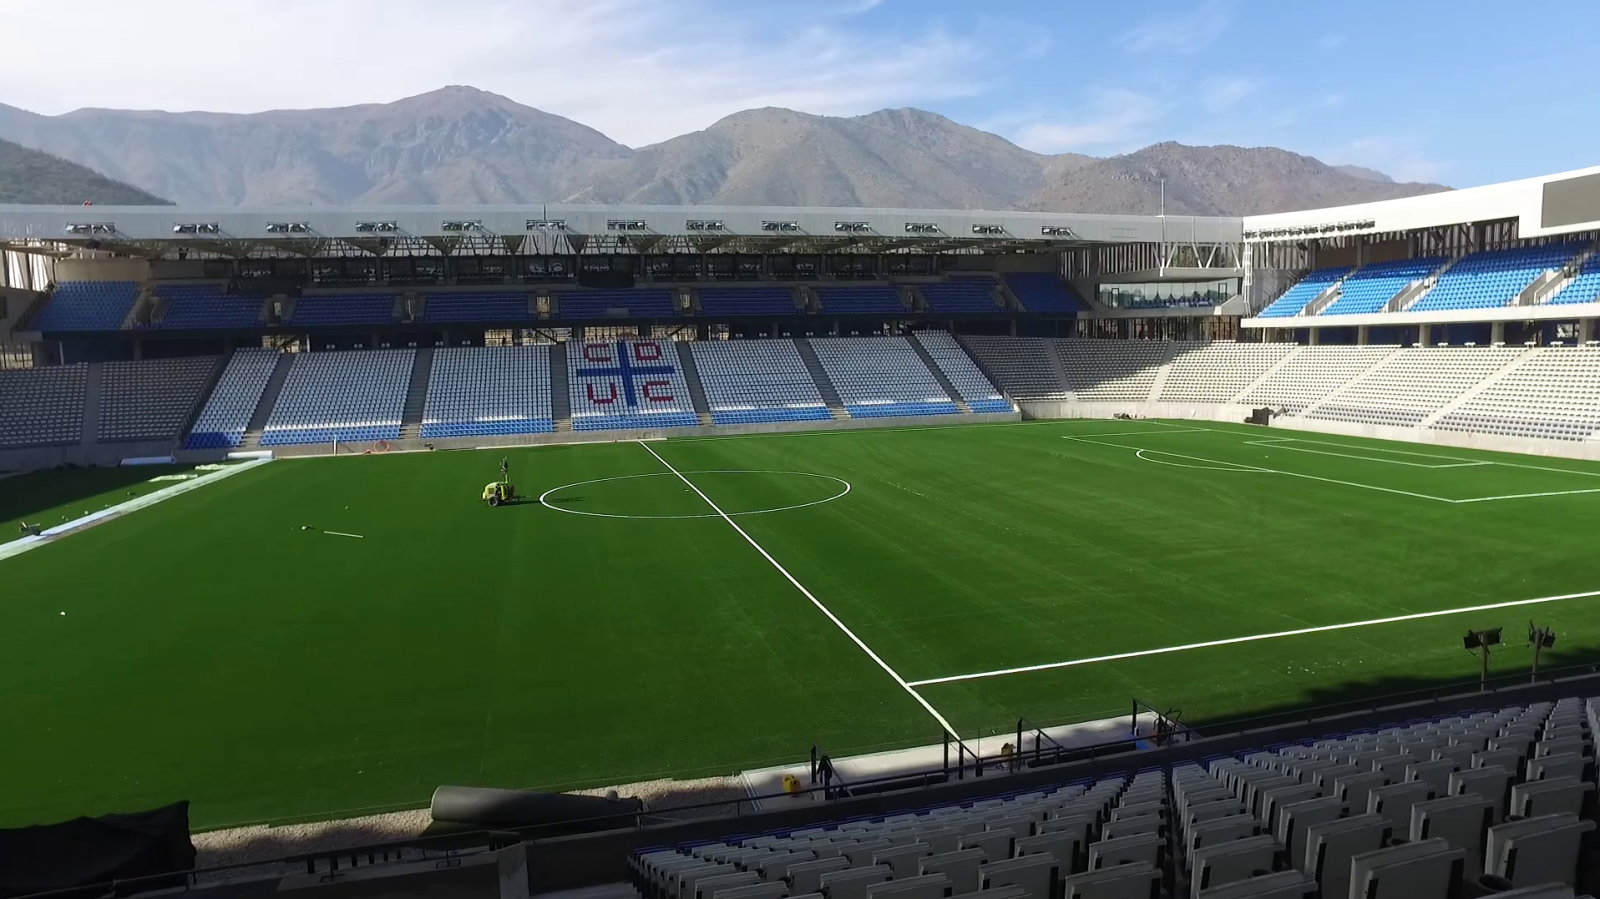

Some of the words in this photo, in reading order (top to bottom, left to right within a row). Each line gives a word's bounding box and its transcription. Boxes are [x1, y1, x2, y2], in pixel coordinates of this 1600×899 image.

[584, 343, 611, 363] C
[634, 342, 662, 361] D
[587, 382, 617, 405] U
[643, 380, 674, 402] C
